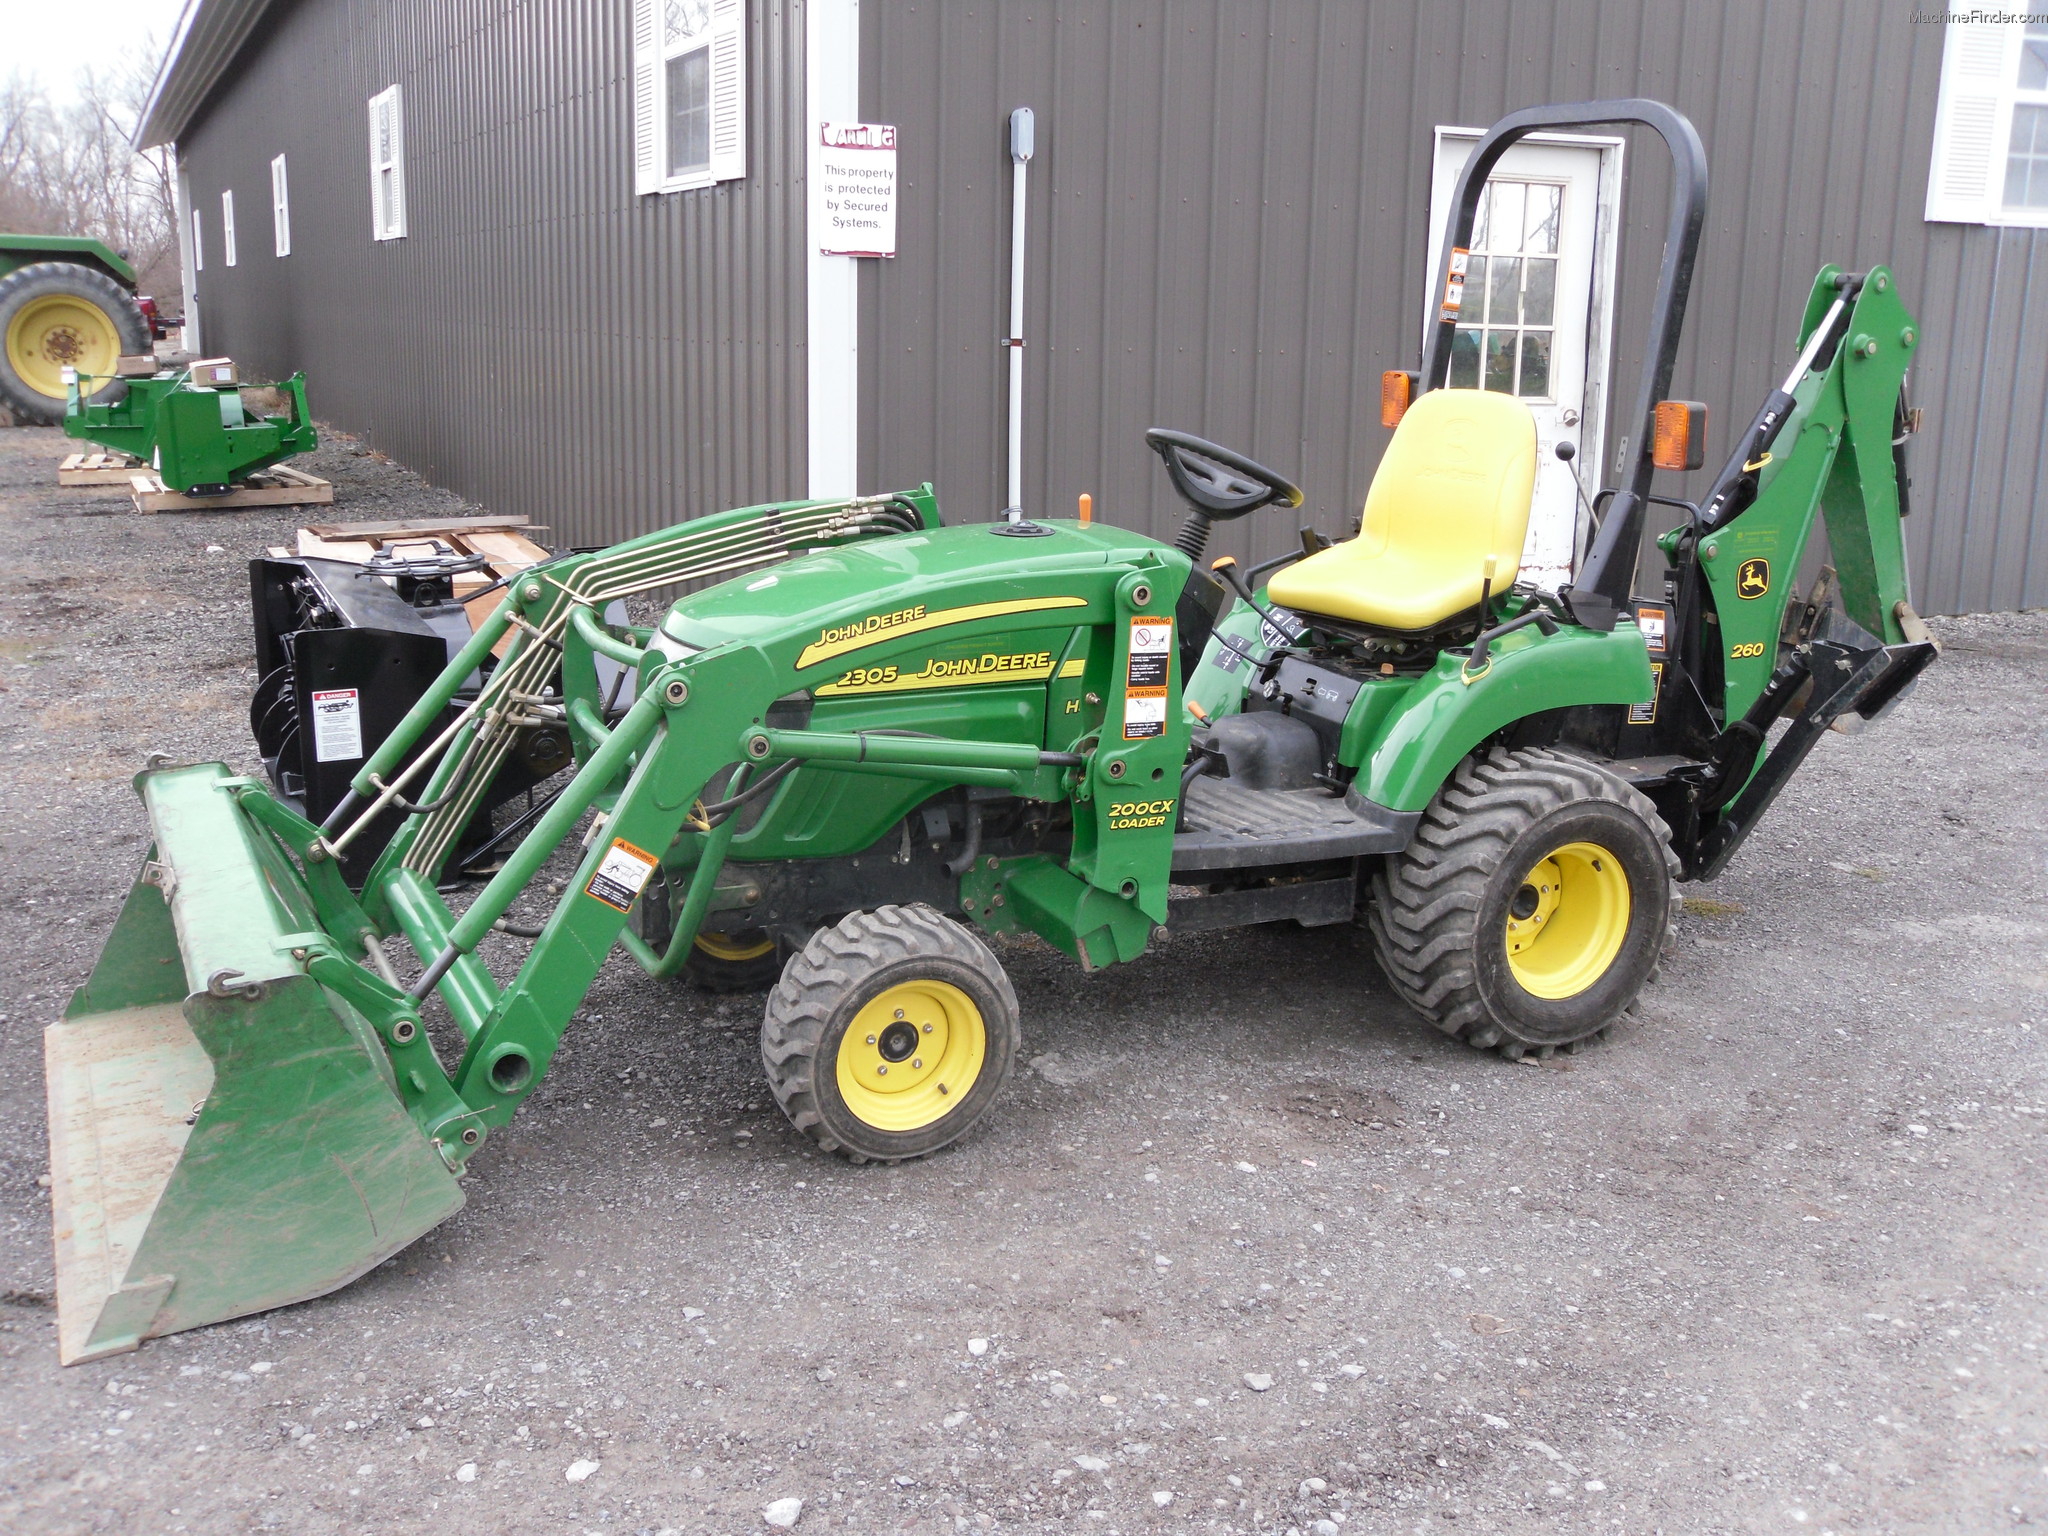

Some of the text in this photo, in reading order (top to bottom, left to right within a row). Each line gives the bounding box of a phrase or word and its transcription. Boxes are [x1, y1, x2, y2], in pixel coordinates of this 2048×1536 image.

[824, 164, 894, 180] This property
[824, 184, 891, 196] is protected
[827, 199, 888, 212] by Secured
[832, 216, 881, 229] Systems.
[814, 604, 926, 647] JOHN DEERE
[1139, 617, 1171, 625] WARNING
[1730, 642, 1764, 659] 260
[917, 651, 1051, 678] JOHN DEERE
[837, 665, 898, 687] 2305
[1134, 689, 1166, 697] WARNING
[1108, 799, 1175, 817] 200CX
[1110, 816, 1166, 830] LOADER
[626, 845, 653, 863] WARNING
